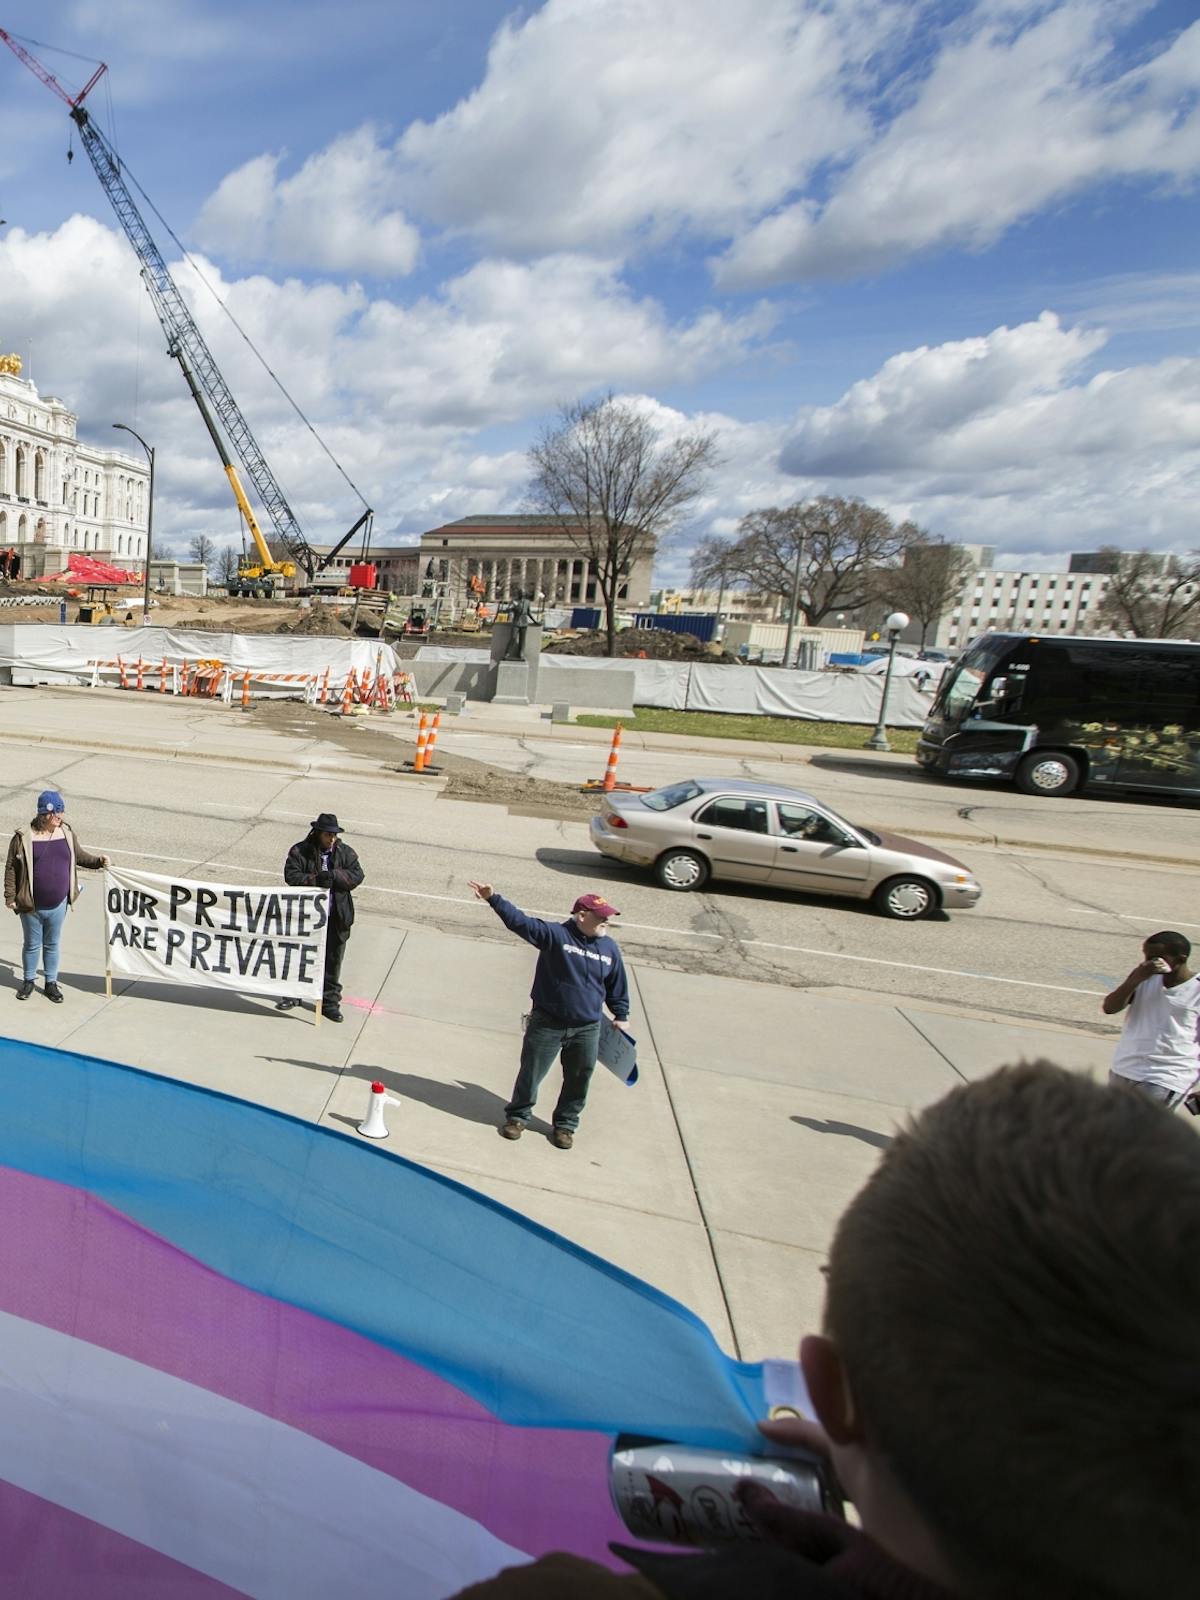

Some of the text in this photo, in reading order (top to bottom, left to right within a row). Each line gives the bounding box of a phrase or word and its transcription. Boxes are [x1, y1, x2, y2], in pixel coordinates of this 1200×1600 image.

[107, 885, 328, 937] OUR PRIVATES
[109, 923, 317, 983] ARE PRIVATE
